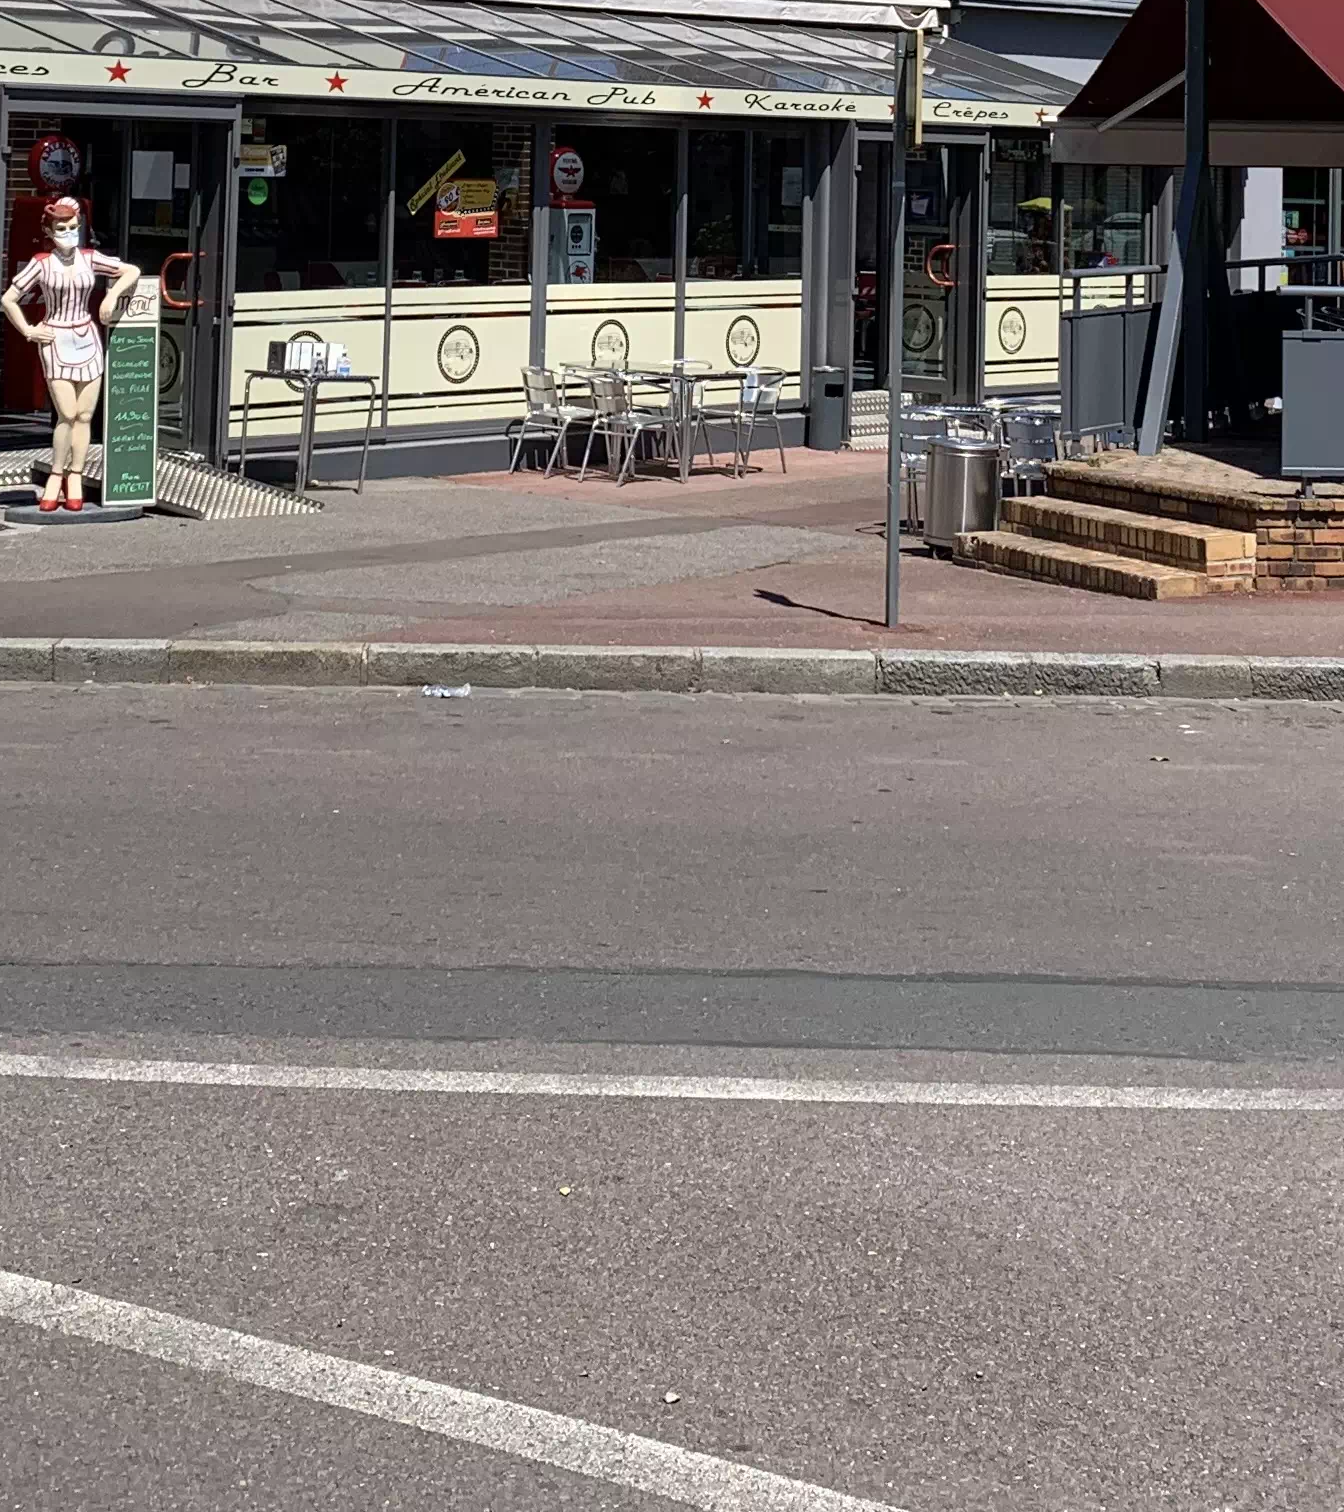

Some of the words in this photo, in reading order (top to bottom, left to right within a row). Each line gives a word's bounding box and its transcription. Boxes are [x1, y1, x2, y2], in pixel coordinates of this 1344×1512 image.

[181, 62, 279, 88] Bar
[392, 76, 571, 102] Américan
[586, 86, 656, 106] Pub
[744, 93, 856, 113] Karaoké
[932, 101, 1009, 122] Crêpes
